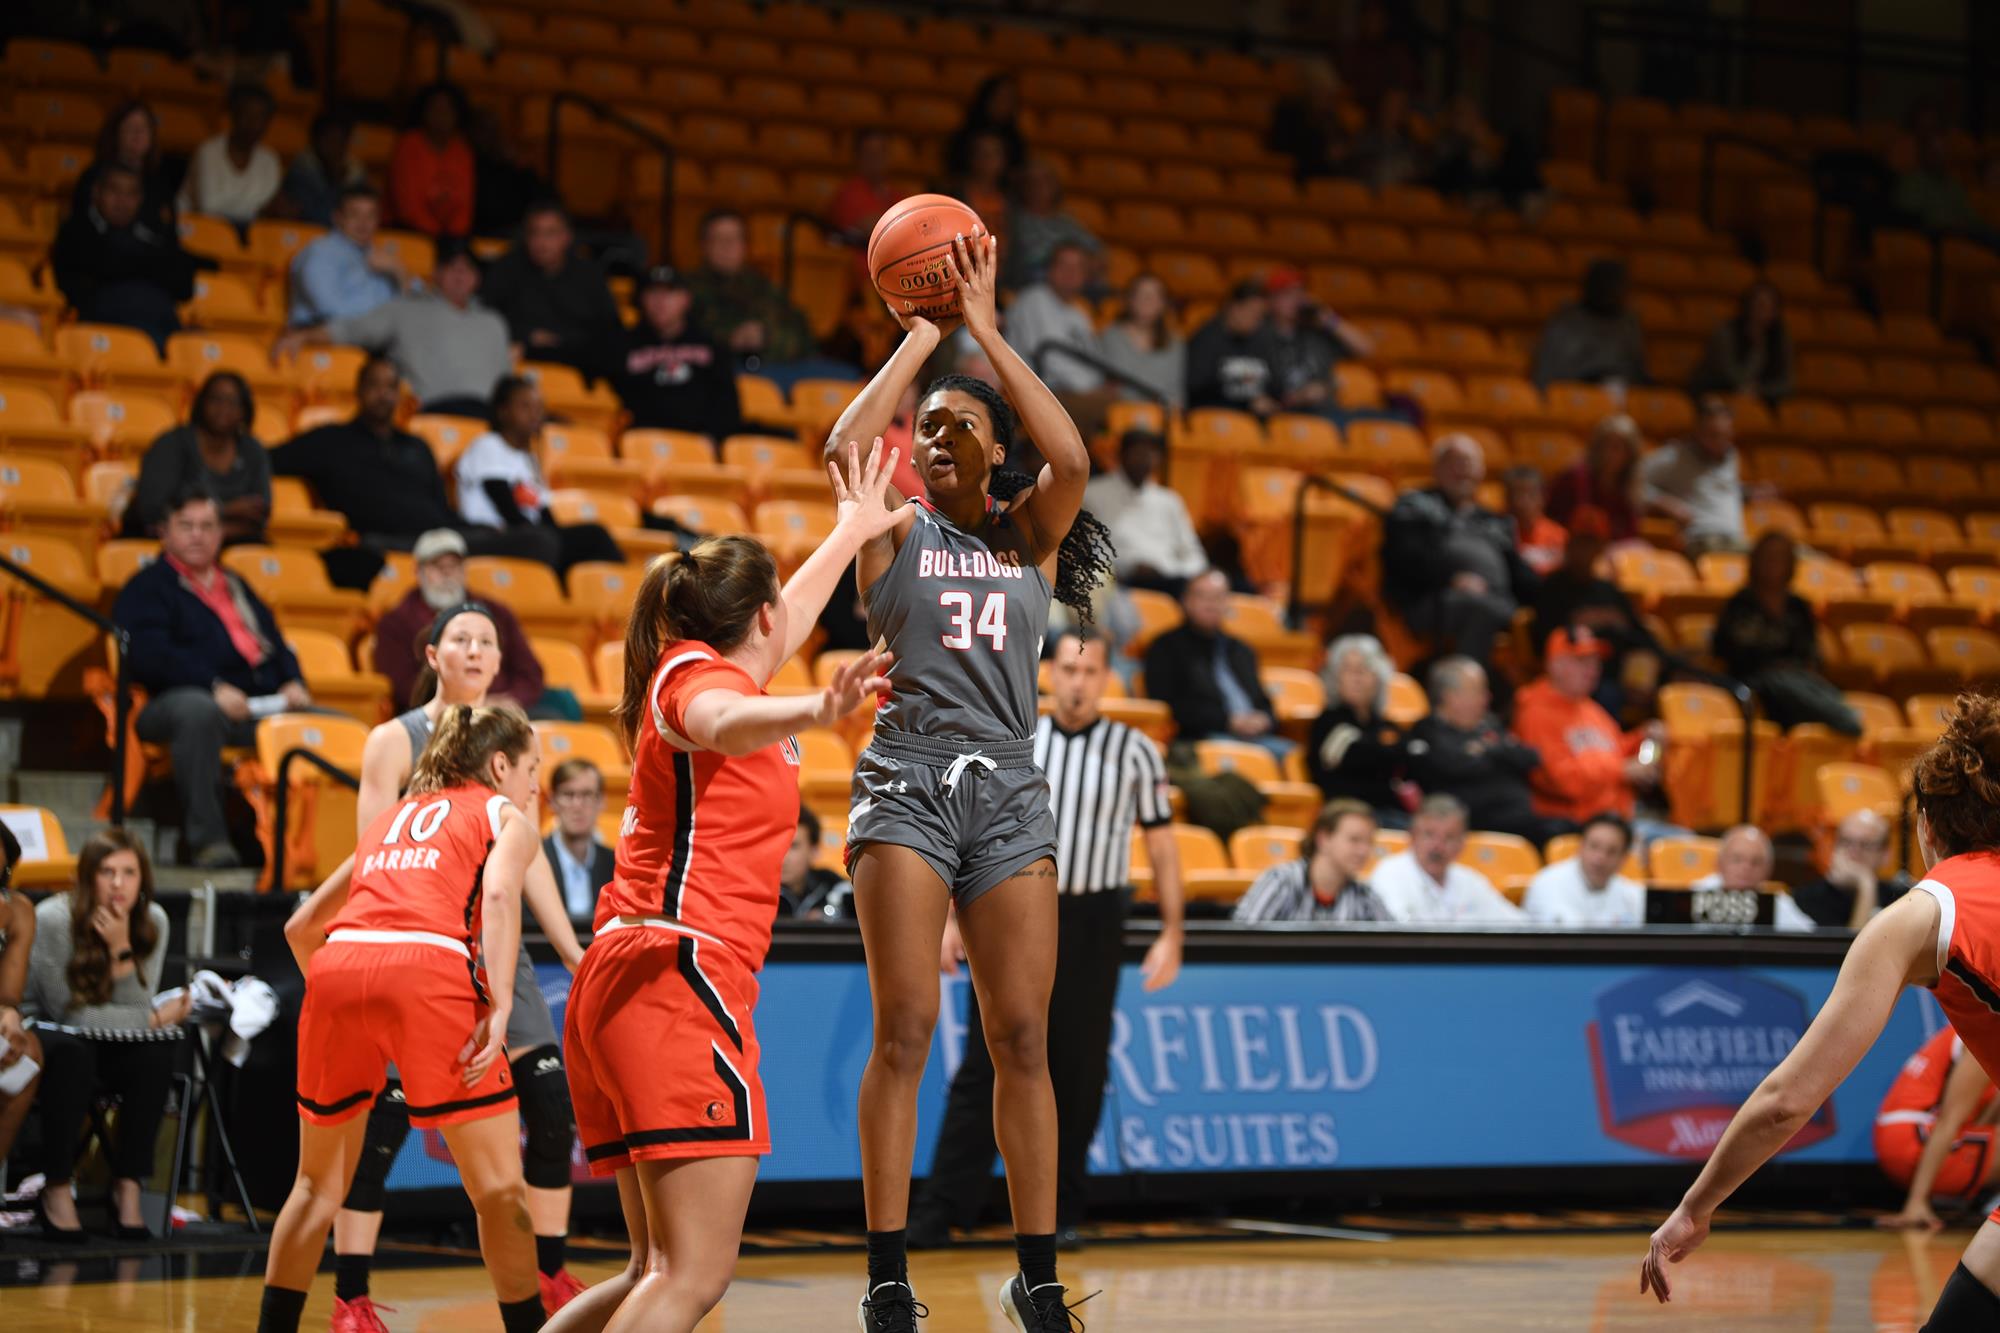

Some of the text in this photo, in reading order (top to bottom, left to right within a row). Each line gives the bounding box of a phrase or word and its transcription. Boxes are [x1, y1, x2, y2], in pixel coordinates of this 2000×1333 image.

[918, 547, 1023, 579] BULLDOGS
[938, 589, 1008, 652] 34
[382, 799, 452, 845] 10
[362, 846, 441, 877] BARBER
[1119, 1115, 1162, 1168] &
[1164, 1111, 1340, 1167] SUITES
